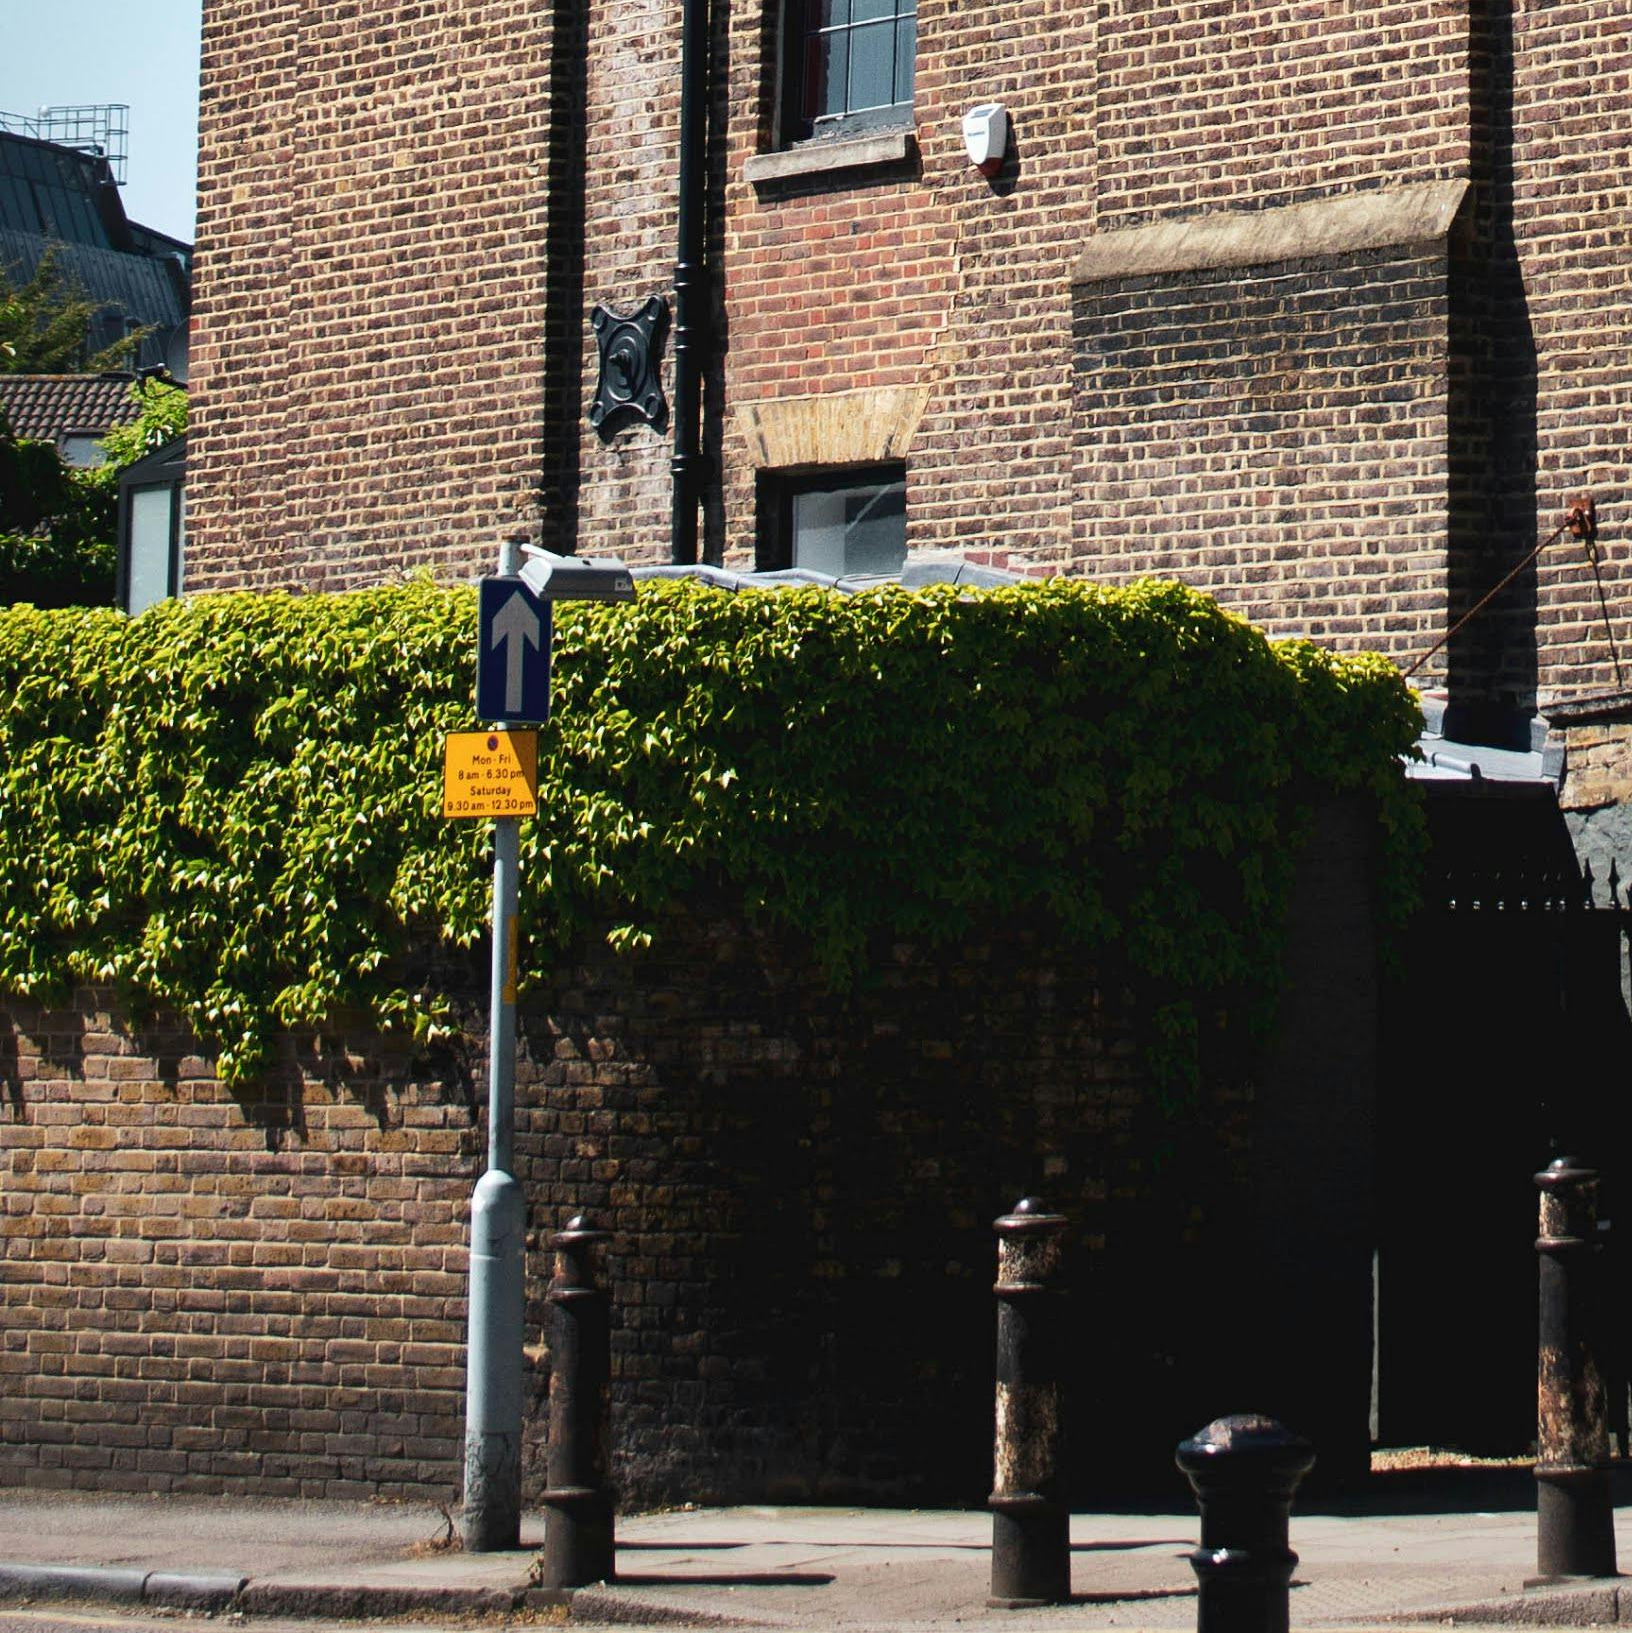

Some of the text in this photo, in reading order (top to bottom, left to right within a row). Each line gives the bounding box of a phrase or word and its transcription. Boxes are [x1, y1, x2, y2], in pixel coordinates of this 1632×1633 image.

[472, 755, 491, 765] Mon
[499, 754, 511, 765] Fri
[458, 769, 464, 780] 8
[466, 772, 480, 780] am
[486, 768, 508, 779] 6.30
[510, 769, 525, 780] pm
[470, 786, 511, 796] Saturday
[447, 800, 469, 811] 9.30
[471, 802, 485, 810] am
[491, 799, 517, 810] 12.30
[519, 800, 534, 811] pm
